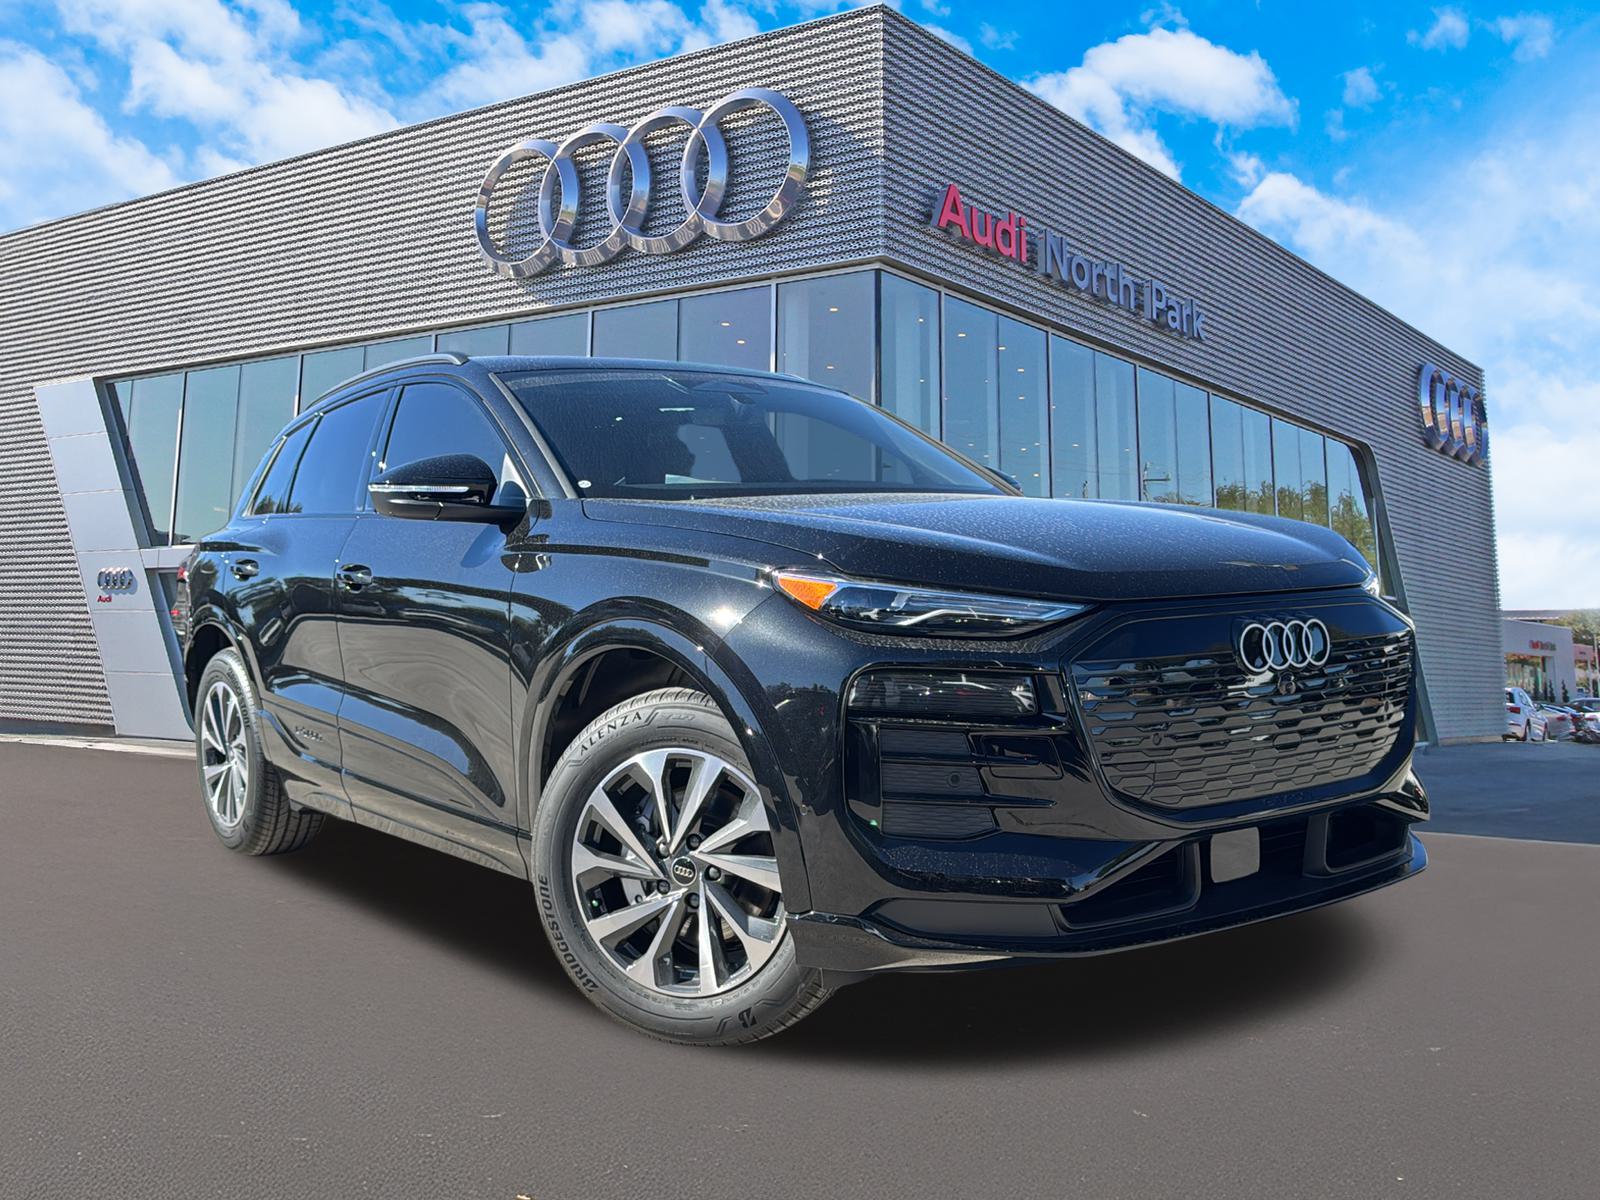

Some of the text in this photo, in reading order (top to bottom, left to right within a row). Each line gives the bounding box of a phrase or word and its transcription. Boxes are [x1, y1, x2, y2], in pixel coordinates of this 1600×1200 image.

[935, 183, 1207, 341] Audi North Park
[580, 711, 642, 756] ALENZA
[538, 874, 599, 993] BRIDGESTONE
